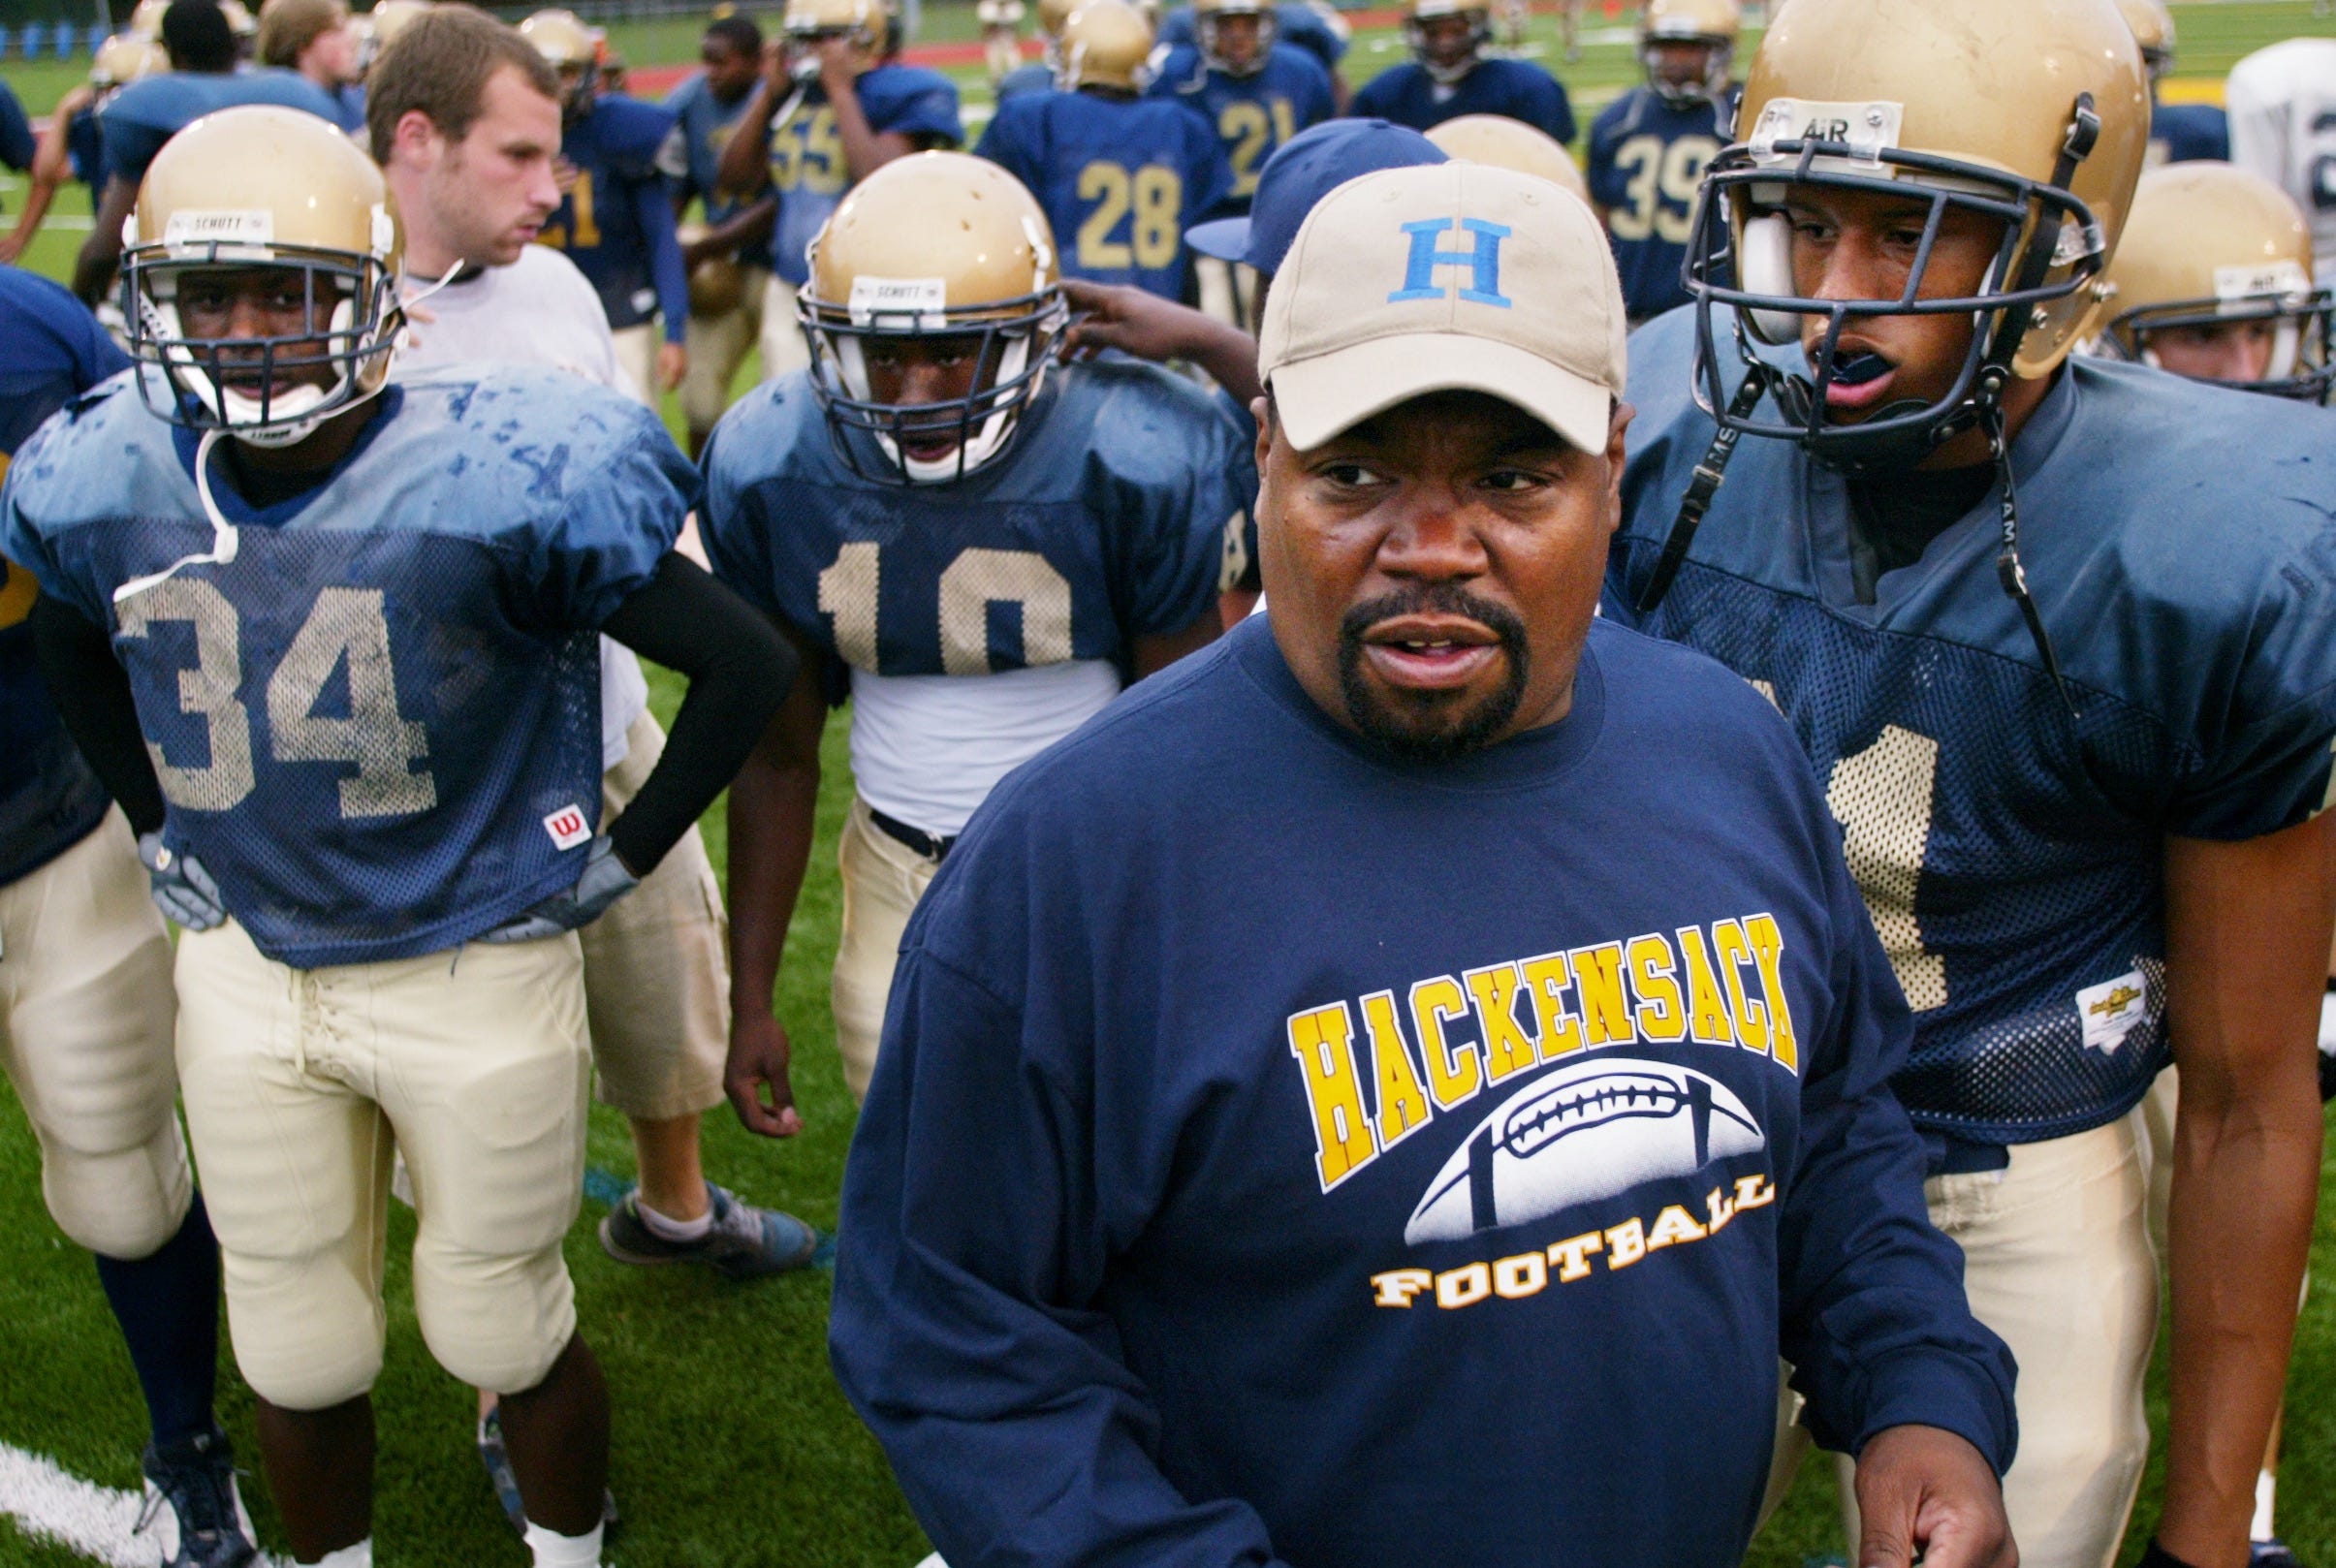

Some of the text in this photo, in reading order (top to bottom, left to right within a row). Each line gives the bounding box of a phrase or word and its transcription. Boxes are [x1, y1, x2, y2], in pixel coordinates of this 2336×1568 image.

[1076, 160, 1183, 269] 28
[1609, 134, 1721, 245] 39
[1387, 216, 1512, 310] H
[114, 576, 437, 819] 34
[552, 812, 581, 836] W
[1287, 912, 1799, 1195] HACKENSACK
[1370, 1174, 1775, 1310] FOOTBALL
